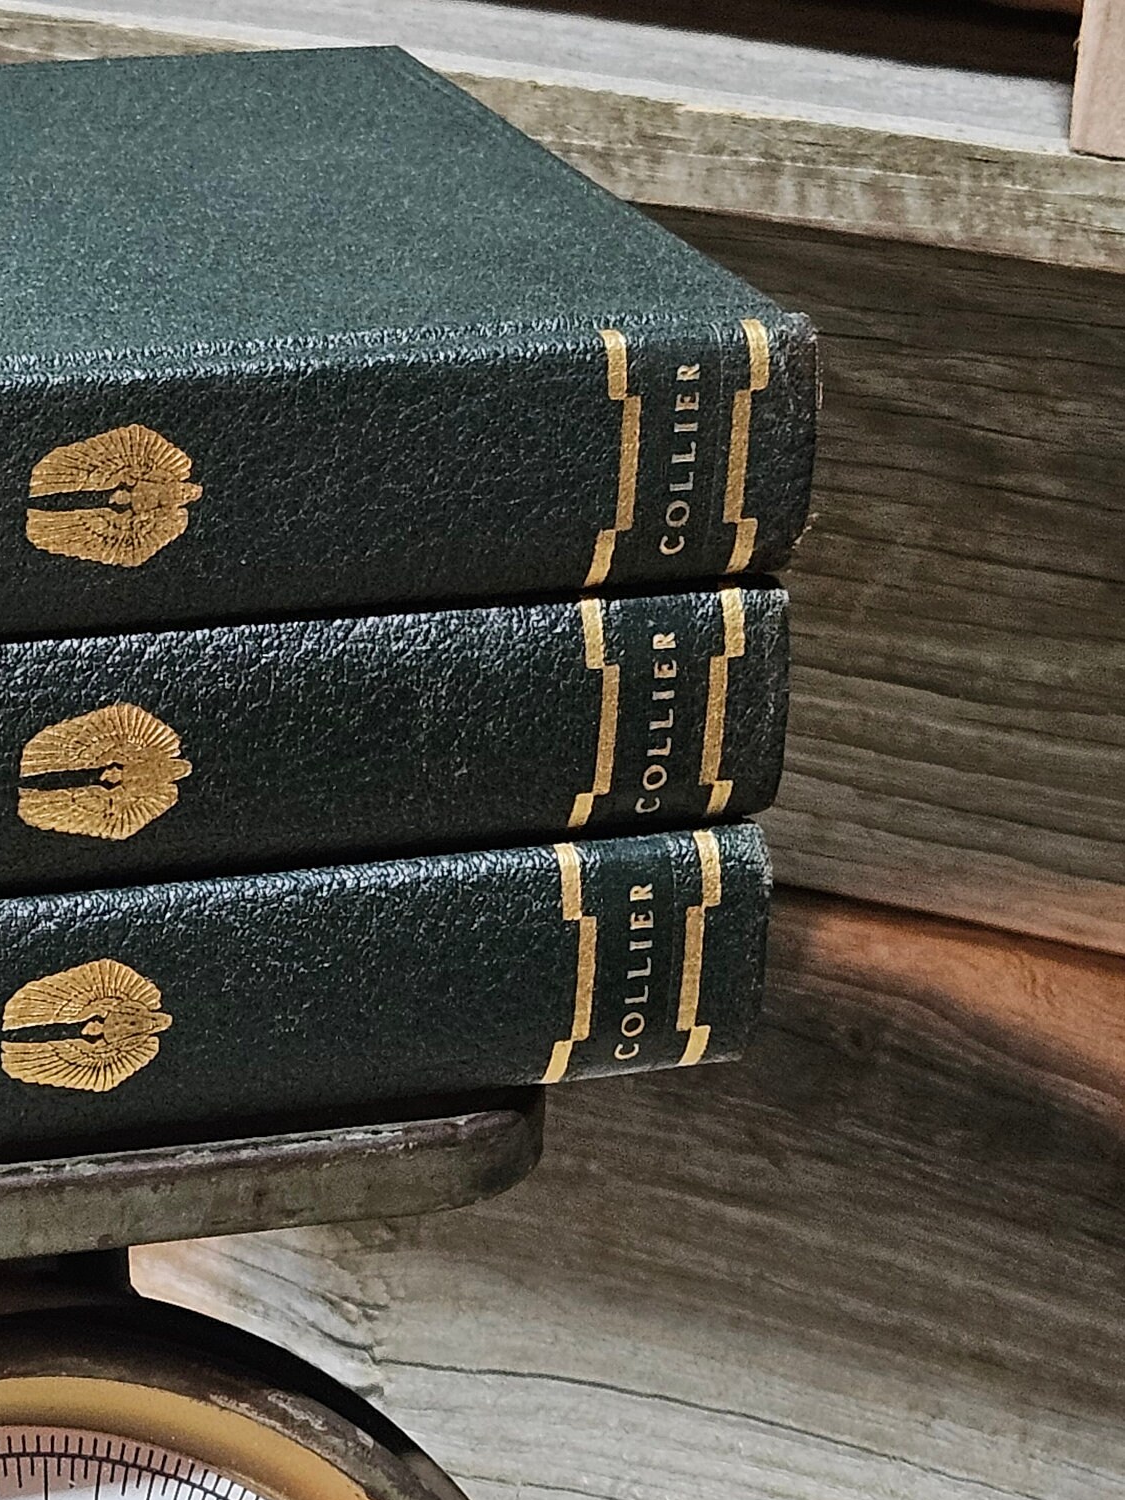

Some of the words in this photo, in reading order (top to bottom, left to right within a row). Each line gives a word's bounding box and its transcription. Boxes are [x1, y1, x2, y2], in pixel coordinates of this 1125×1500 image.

[660, 361, 703, 557] COLLIER
[636, 629, 678, 815] COLLIER
[614, 881, 656, 1063] COLLIER
